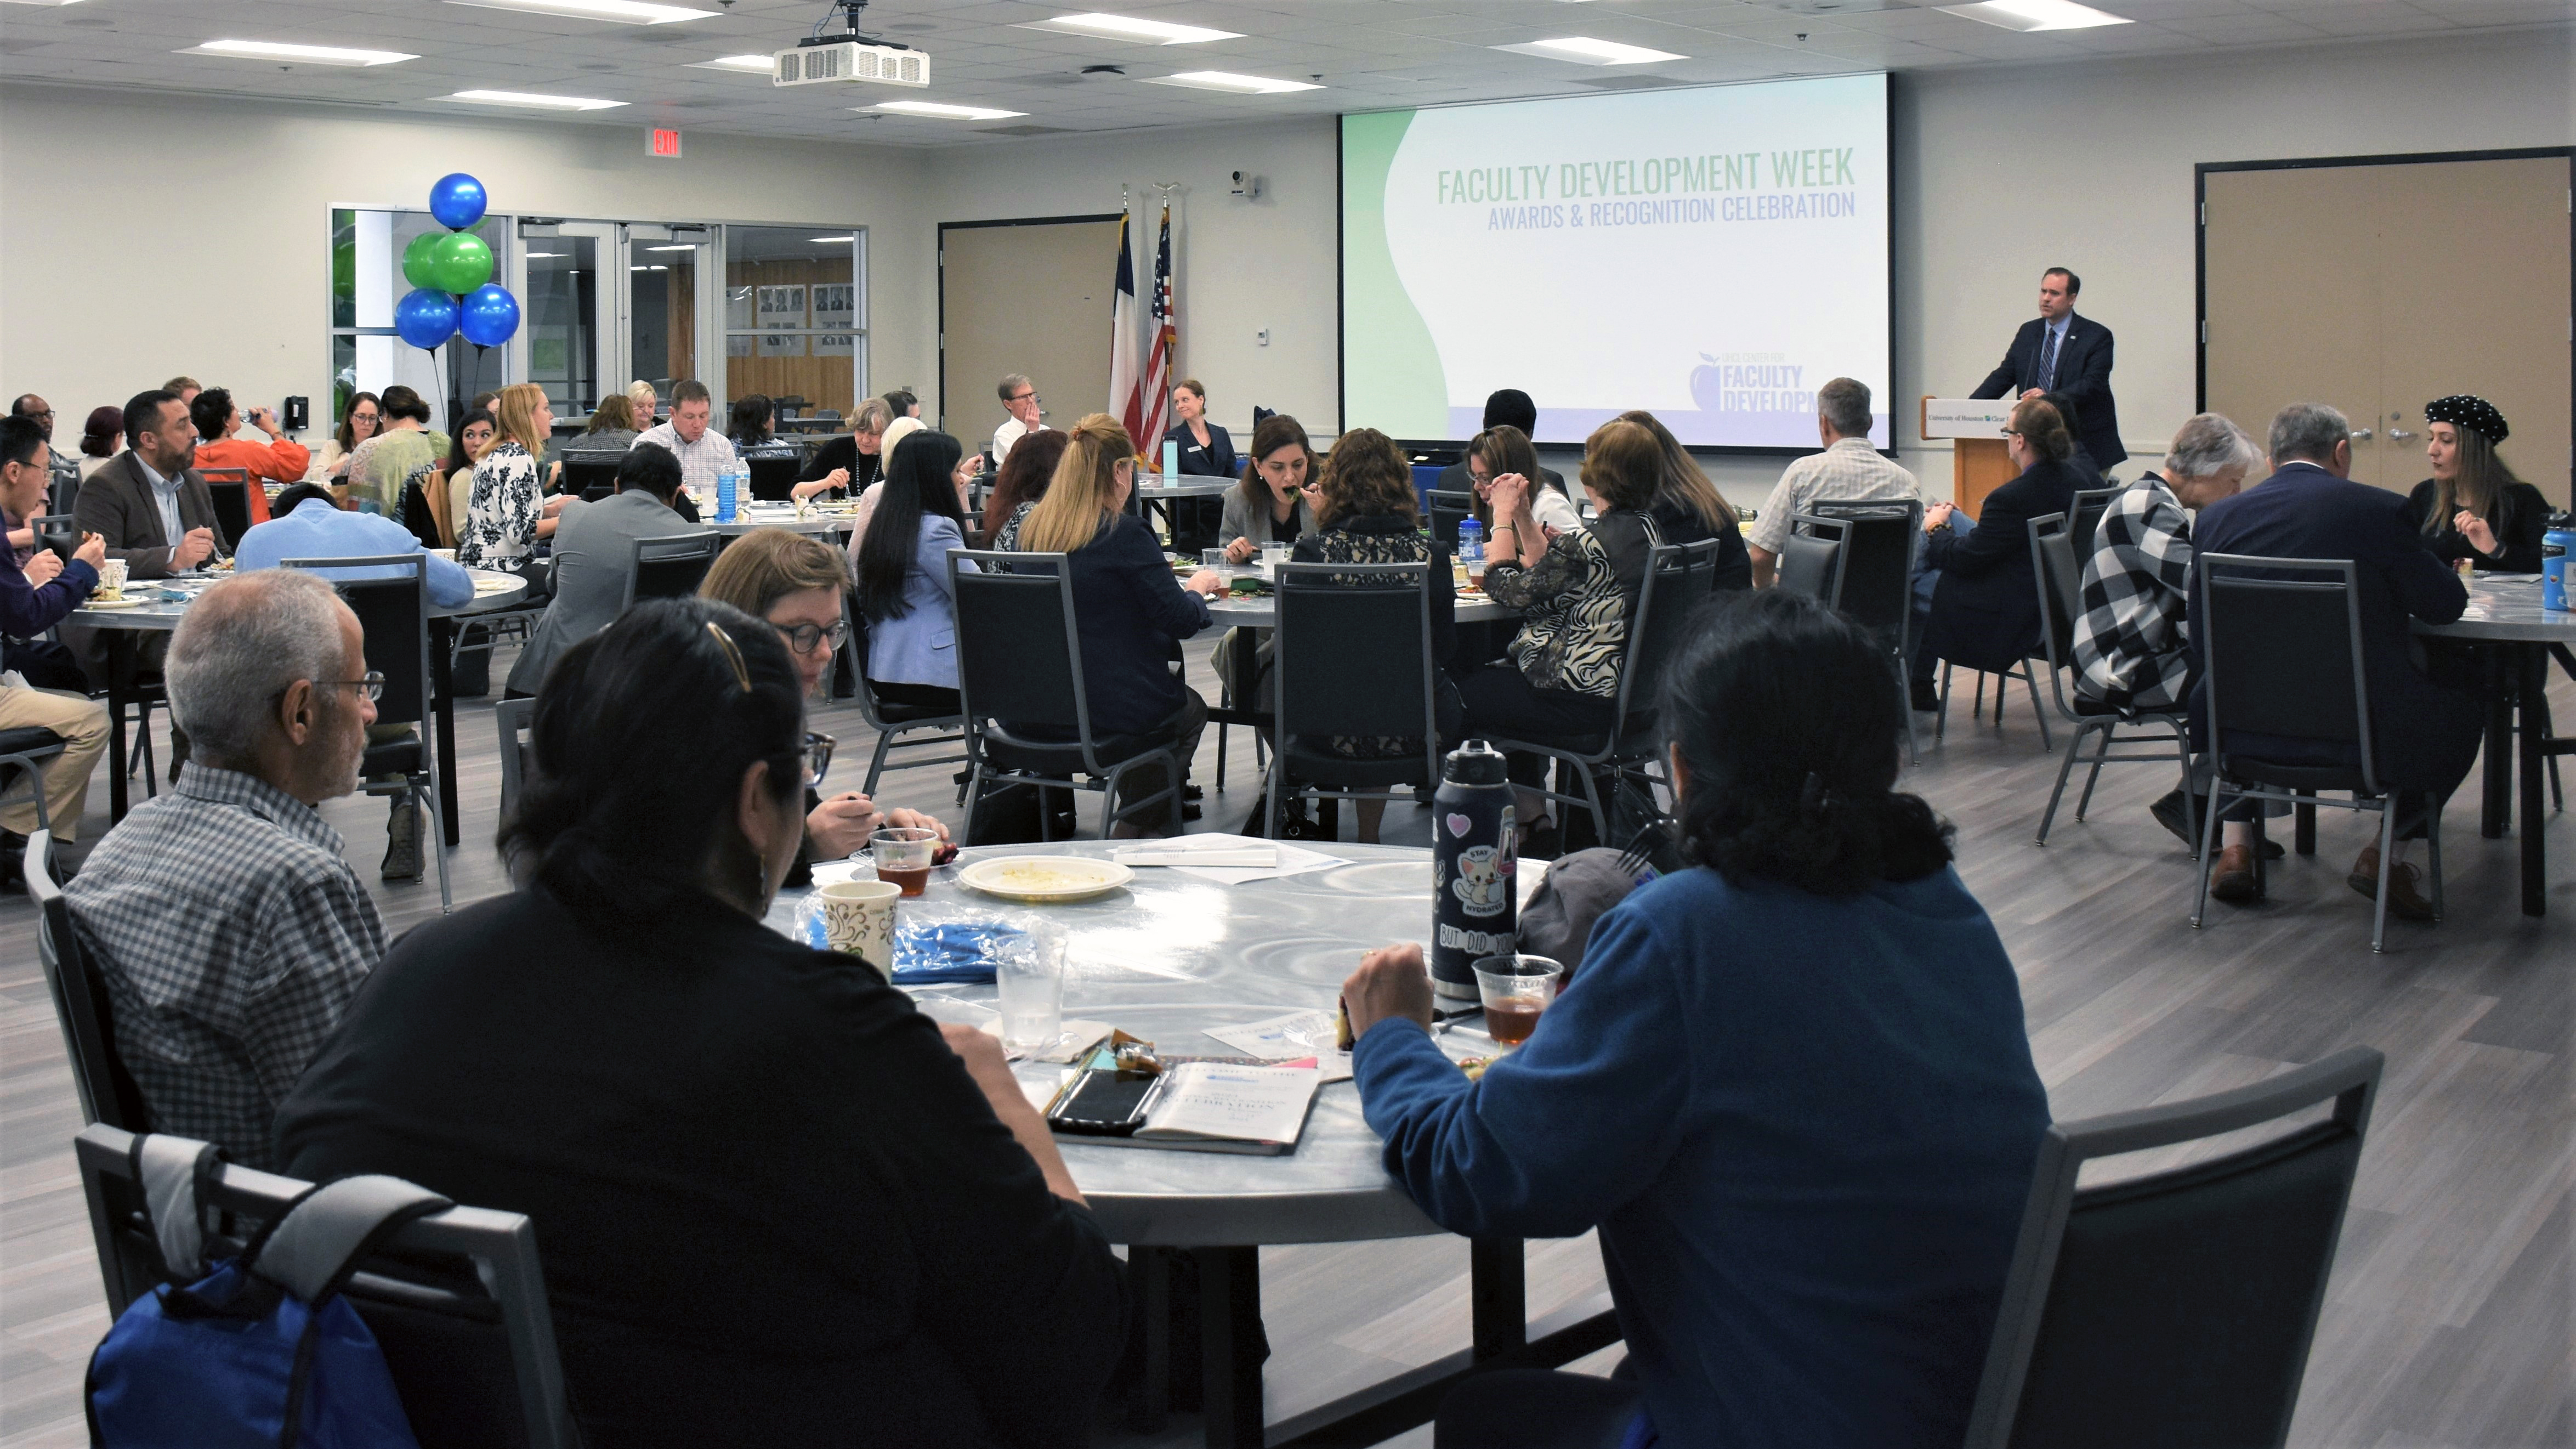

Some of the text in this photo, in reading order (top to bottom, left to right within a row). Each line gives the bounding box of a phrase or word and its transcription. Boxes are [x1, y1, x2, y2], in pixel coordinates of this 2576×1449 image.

[654, 129, 678, 155] EXIT
[1438, 147, 1855, 204] FACULTY DEVELOPMENT WEEK
[1488, 192, 1855, 230] AWARDS & RECOGNITION CELEBRATION
[1743, 353, 1769, 362] CENTER
[1771, 353, 1785, 363] FOR
[1724, 365, 1803, 388] FACULTY
[1724, 390, 1818, 411] DEVELOPM
[1466, 902, 1503, 913] HYDRATED
[1441, 926, 1459, 945] BUT
[1467, 932, 1486, 951] DID
